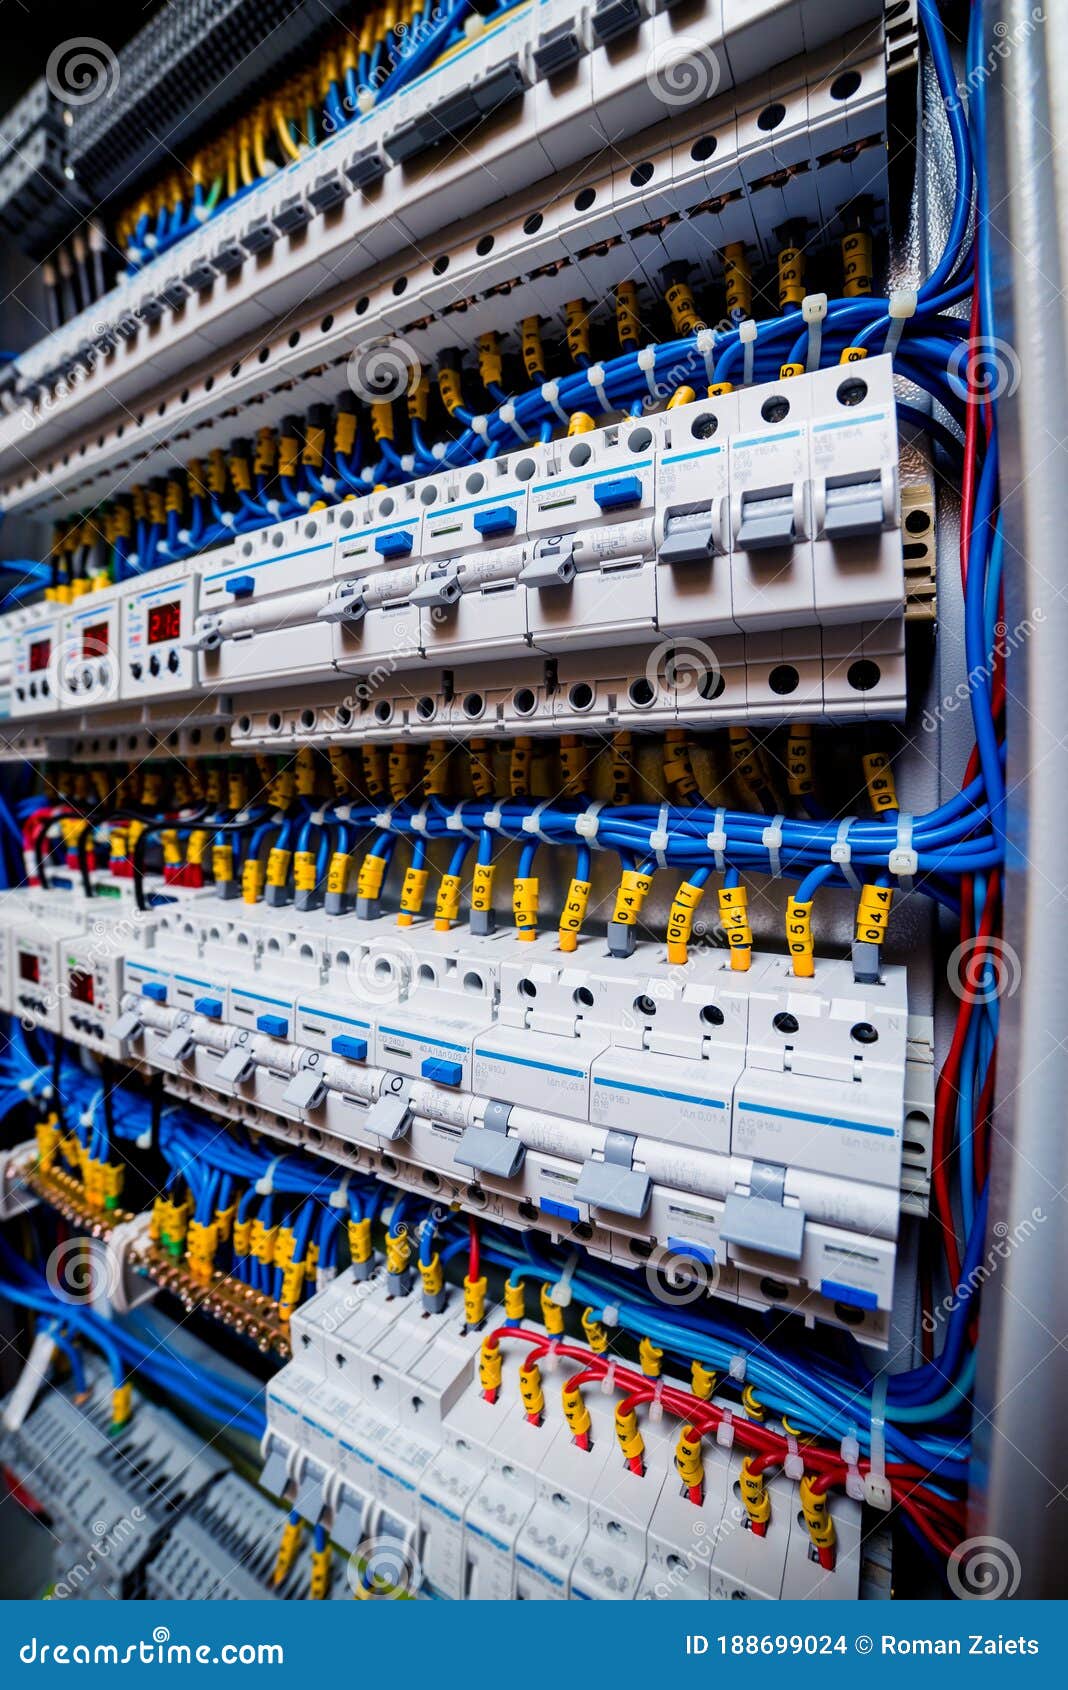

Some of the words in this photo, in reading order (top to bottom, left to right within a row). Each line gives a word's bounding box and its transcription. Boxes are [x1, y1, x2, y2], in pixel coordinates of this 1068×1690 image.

[474, 867, 491, 909] 052
[567, 883, 590, 929] 052
[616, 879, 650, 922] 043
[669, 889, 693, 939] 051
[721, 891, 744, 943] 044
[789, 907, 808, 954] 050
[864, 889, 890, 941] 044
